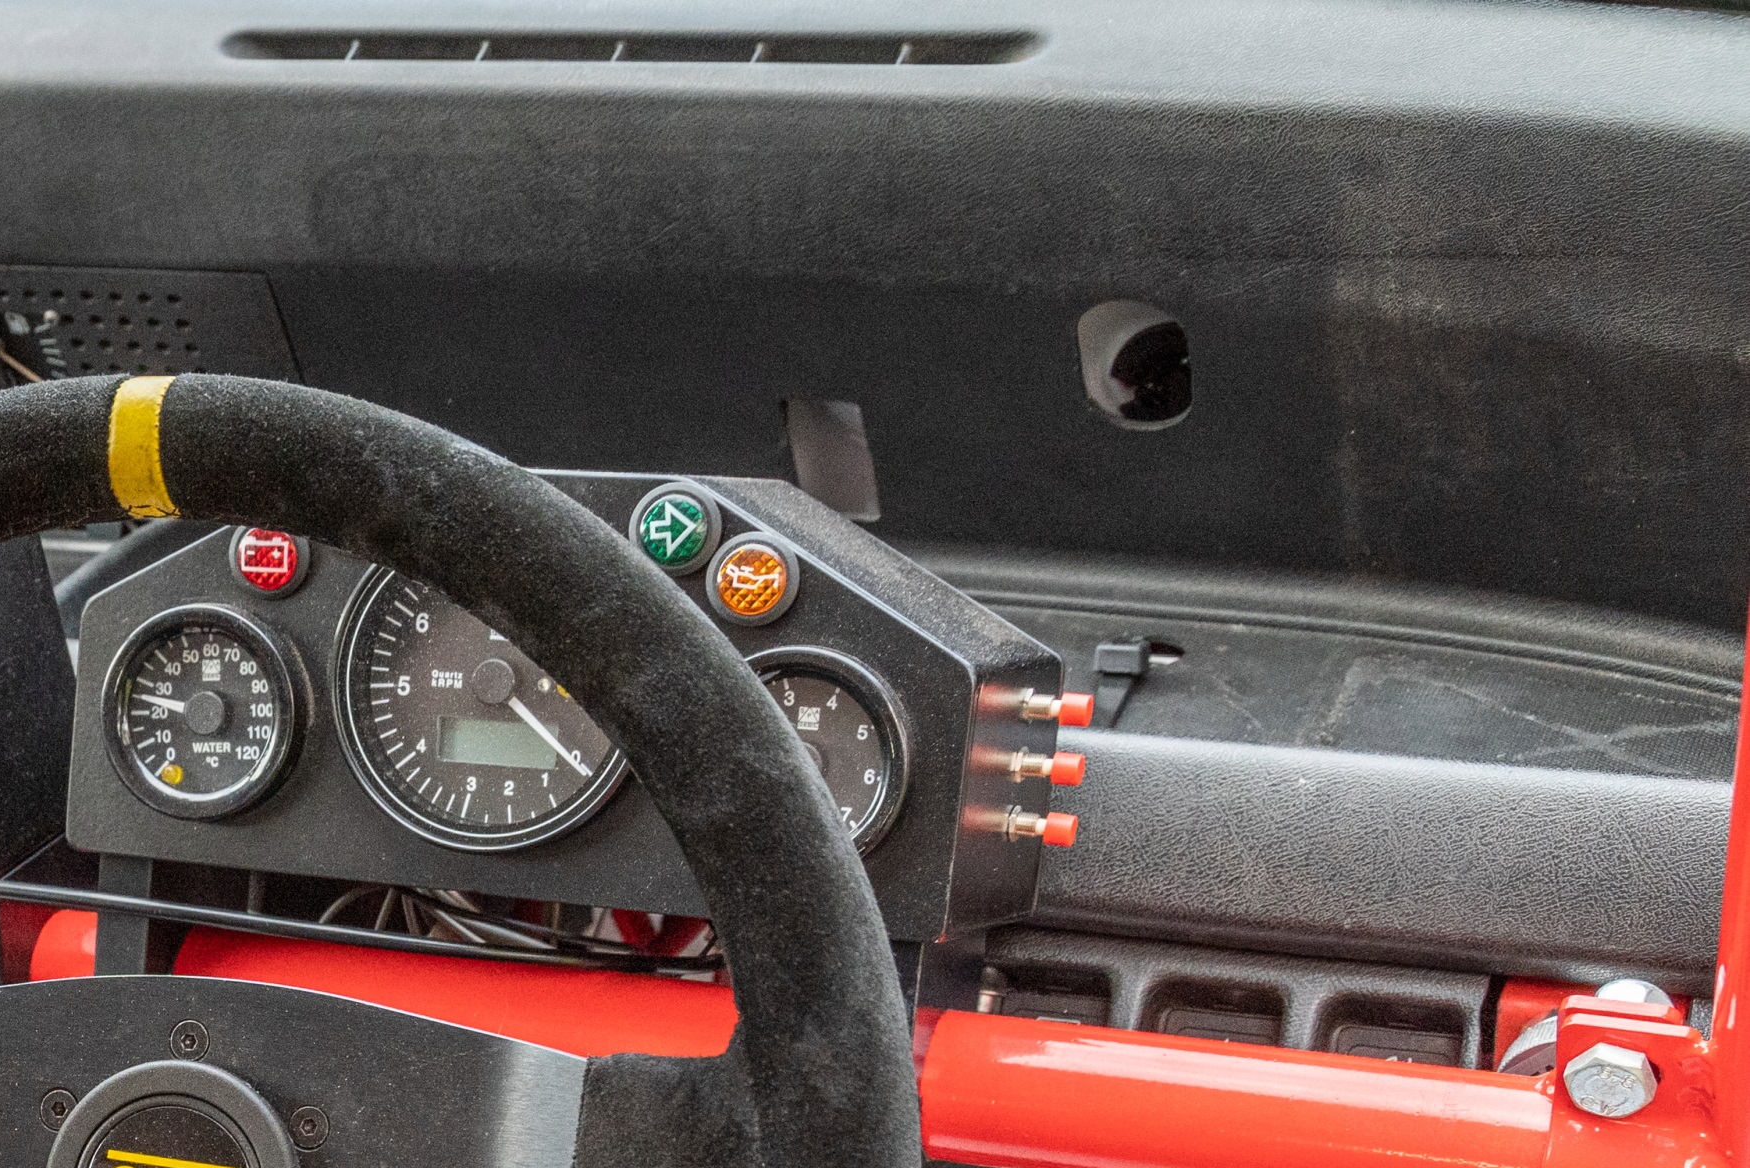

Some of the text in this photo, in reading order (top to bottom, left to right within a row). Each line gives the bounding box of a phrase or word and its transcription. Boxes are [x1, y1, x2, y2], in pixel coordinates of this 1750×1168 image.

[415, 612, 429, 633] 6
[182, 649, 199, 663] 50
[203, 643, 220, 657] 60
[223, 648, 240, 662] 70
[164, 662, 181, 675] 40
[240, 661, 257, 675] 80
[431, 669, 463, 679] Quartz
[155, 682, 172, 695] 30
[251, 680, 268, 693] 90
[397, 675, 410, 696] 5
[783, 690, 795, 706] 3
[826, 694, 838, 710] 4
[151, 706, 168, 719] 20
[250, 703, 273, 717] 100
[155, 730, 171, 743] 10
[247, 725, 270, 739] 110
[857, 725, 868, 740] 5
[192, 742, 231, 753] WATER
[235, 745, 260, 760] 120
[416, 739, 427, 753] 4
[166, 747, 176, 761] 0
[541, 773, 548, 787] 1
[864, 769, 875, 785] 6
[466, 777, 477, 792] 3
[504, 781, 514, 796] 2
